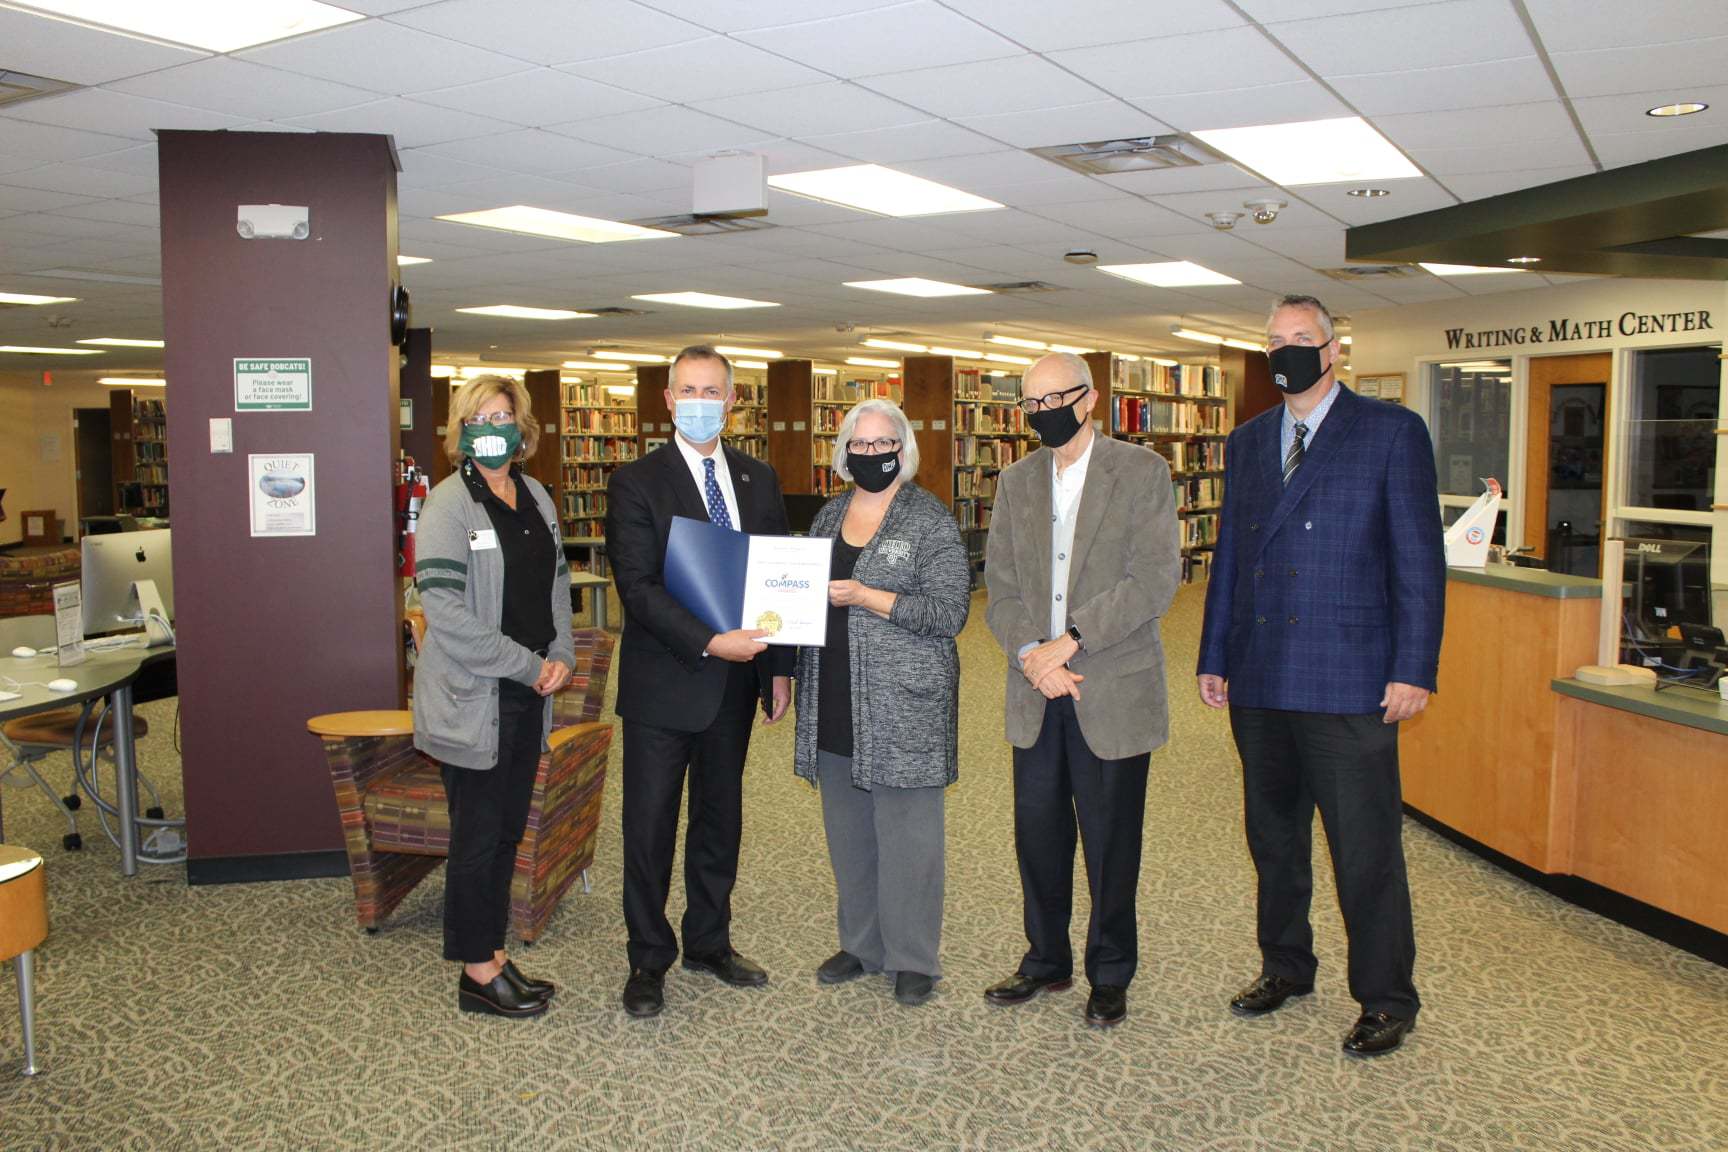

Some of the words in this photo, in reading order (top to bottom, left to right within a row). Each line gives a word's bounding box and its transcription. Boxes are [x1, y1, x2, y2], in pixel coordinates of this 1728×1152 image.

[1445, 327, 1526, 350] WRITING
[1530, 326, 1543, 344] &
[1548, 319, 1612, 343] MATH
[1619, 310, 1713, 337] CENTER
[250, 362, 269, 371] SAFE
[765, 579, 810, 589] COMPASS
